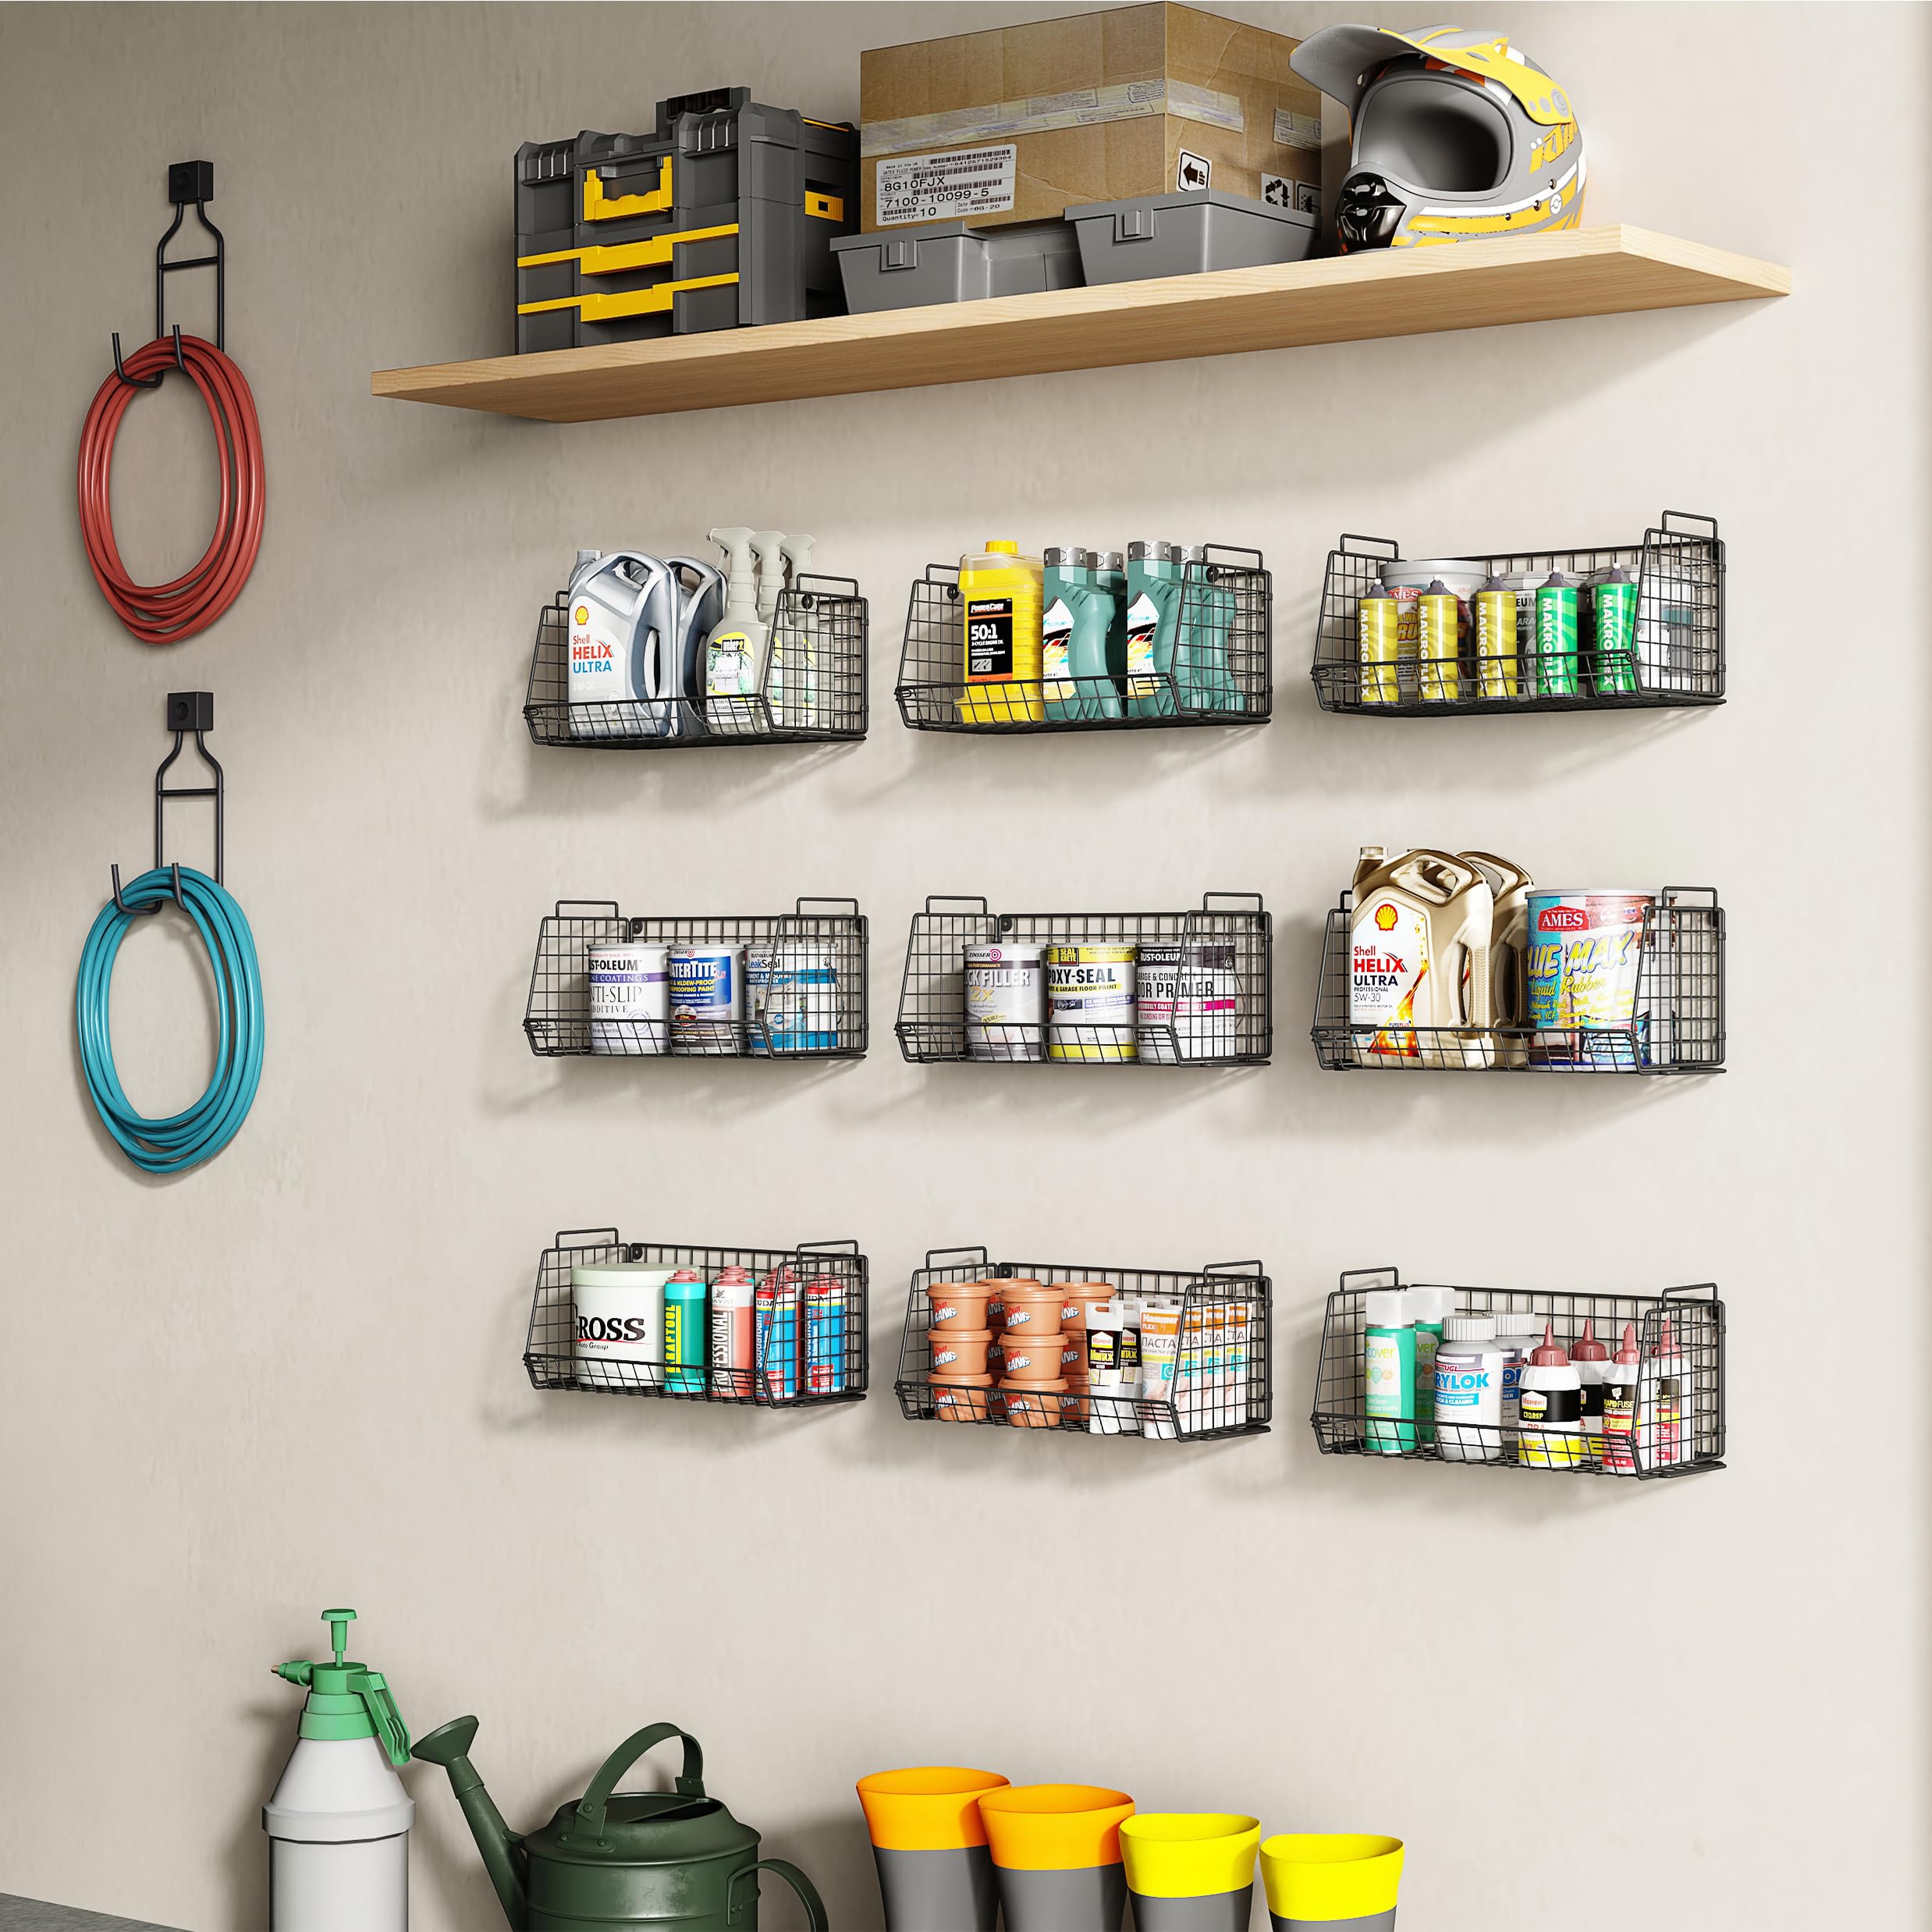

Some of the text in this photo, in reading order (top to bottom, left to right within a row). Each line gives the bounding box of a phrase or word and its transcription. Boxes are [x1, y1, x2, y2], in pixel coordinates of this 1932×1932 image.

[884, 176, 945, 191] 8G10FJX
[1198, 171, 1206, 186] UP
[920, 207, 936, 217] 10
[573, 634, 590, 645] Shell
[971, 623, 998, 641] 50:1
[573, 644, 613, 660] HELIX
[573, 660, 613, 673] ULTRA
[1542, 913, 1584, 927] AMES
[1354, 945, 1376, 956] Shell
[1527, 929, 1635, 978] LUE MAX
[1354, 956, 1407, 973] HELIX
[982, 968, 1030, 987] FILLER
[1048, 968, 1116, 984] POXY-SEAL
[1152, 972, 1158, 981] &
[1354, 975, 1398, 986] ULTRA
[1157, 981, 1213, 998] PRMER
[1531, 974, 1607, 1001] Liquid Rubber
[1354, 993, 1381, 1002] 5W-30
[576, 1312, 645, 1341] ROSS
[588, 1341, 609, 1351] Group
[665, 1305, 676, 1373] KRAFTOOL
[1142, 1337, 1176, 1349] ПАСТА
[1435, 1373, 1490, 1390] RYLOK
